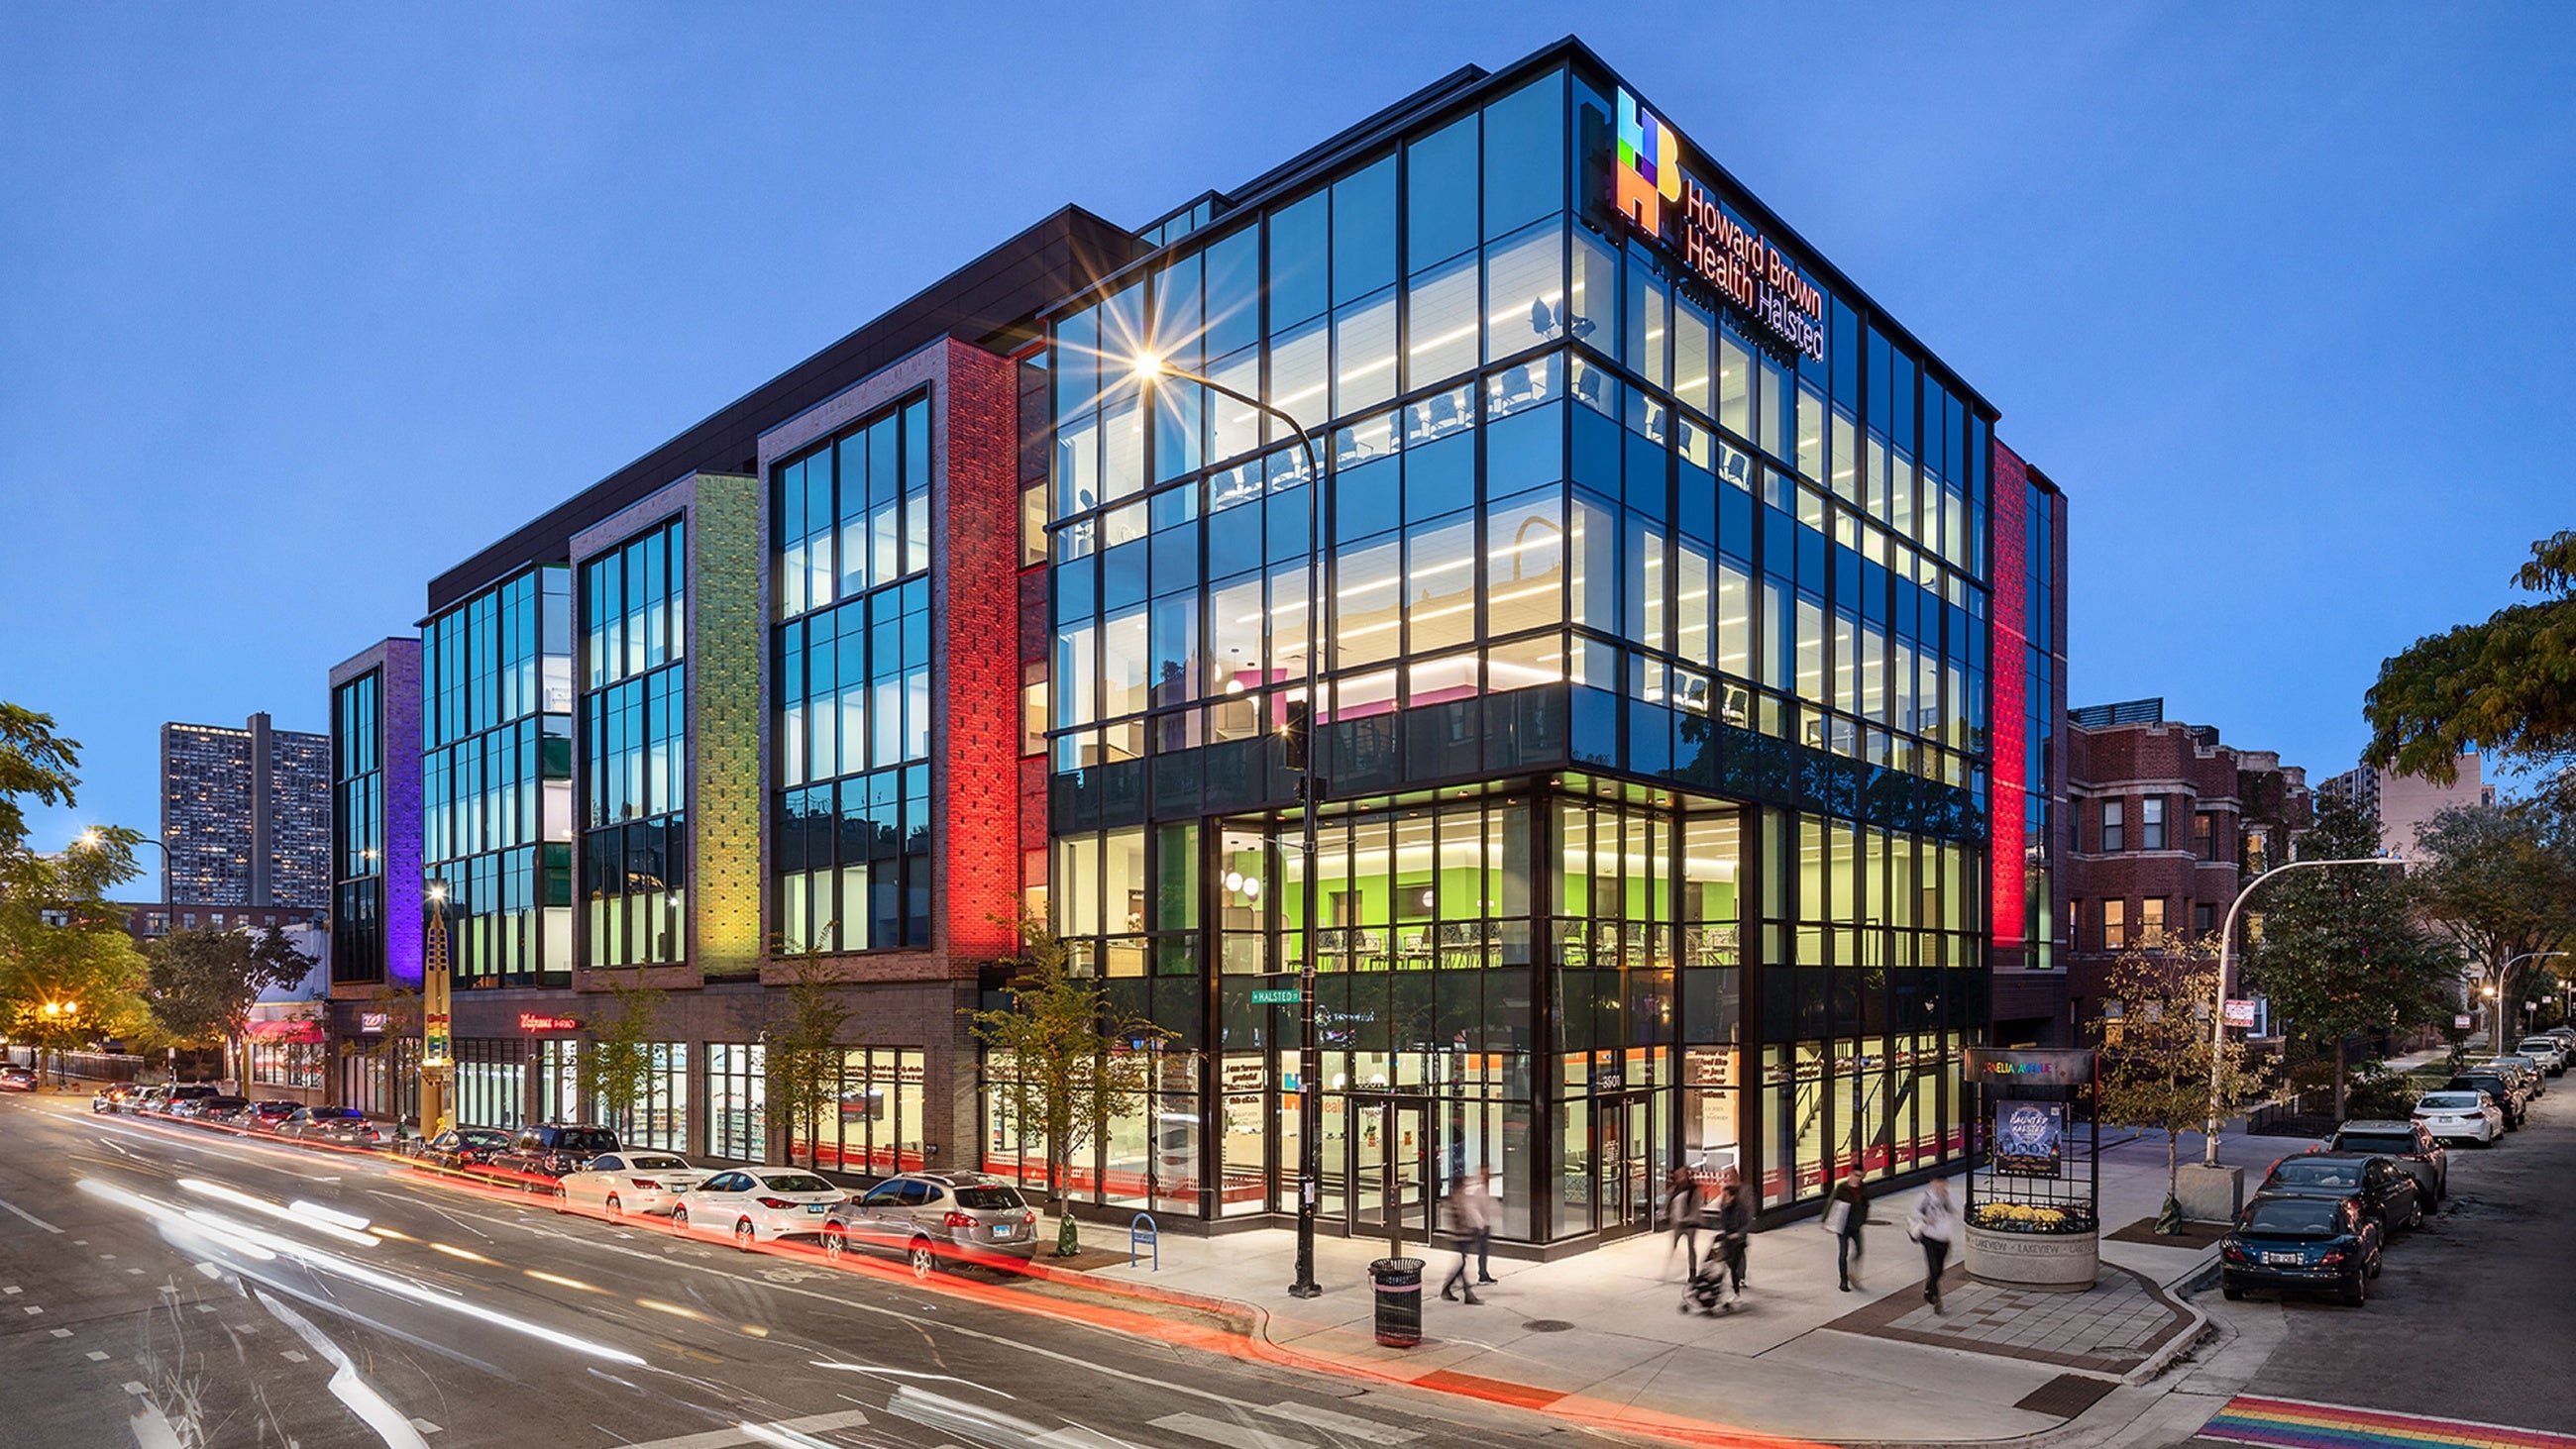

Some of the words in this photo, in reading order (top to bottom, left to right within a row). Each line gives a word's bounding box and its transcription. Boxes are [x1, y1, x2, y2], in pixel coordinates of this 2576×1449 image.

[1687, 179, 1764, 274] Howard
[1770, 248, 1821, 321] Brown
[1687, 225, 1753, 308] Health
[1759, 280, 1823, 362] Halsted
[1258, 991, 1292, 1001] HALSTED
[2018, 1063, 2052, 1074] AVENUE
[1602, 1075, 1621, 1088] 3501
[2017, 1243, 2059, 1254] LAKEVIEW
